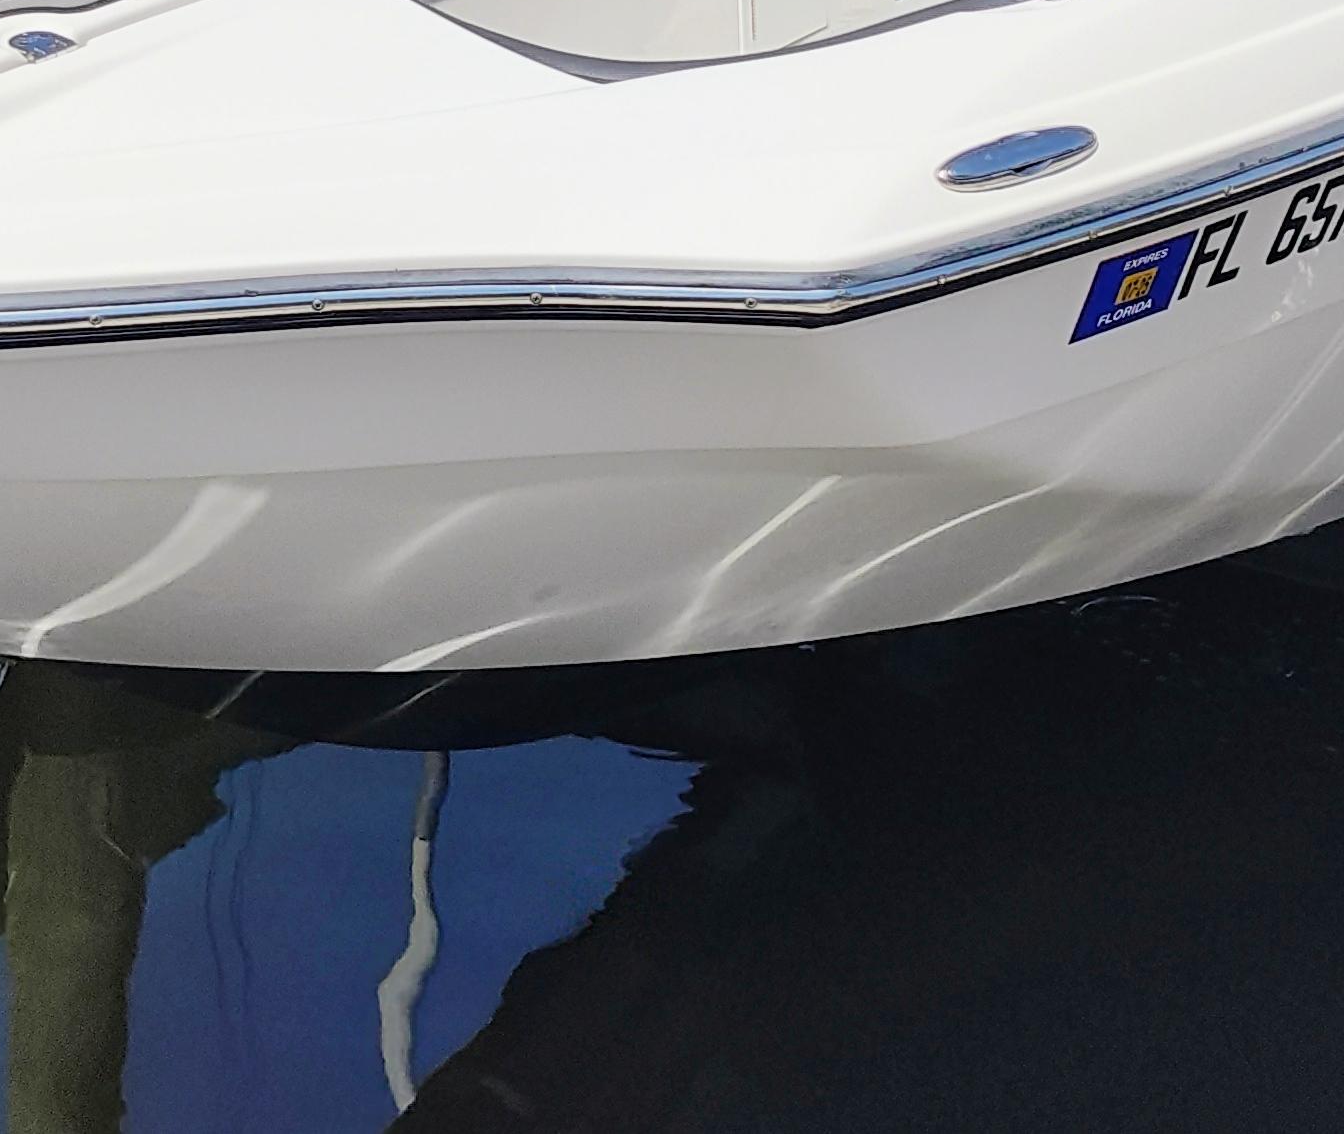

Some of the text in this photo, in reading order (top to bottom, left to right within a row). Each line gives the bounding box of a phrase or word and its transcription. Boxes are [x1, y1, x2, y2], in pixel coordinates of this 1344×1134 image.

[1123, 248, 1169, 272] EXPIRES
[1177, 210, 1248, 300] FL
[1097, 298, 1153, 327] FLORIDA
